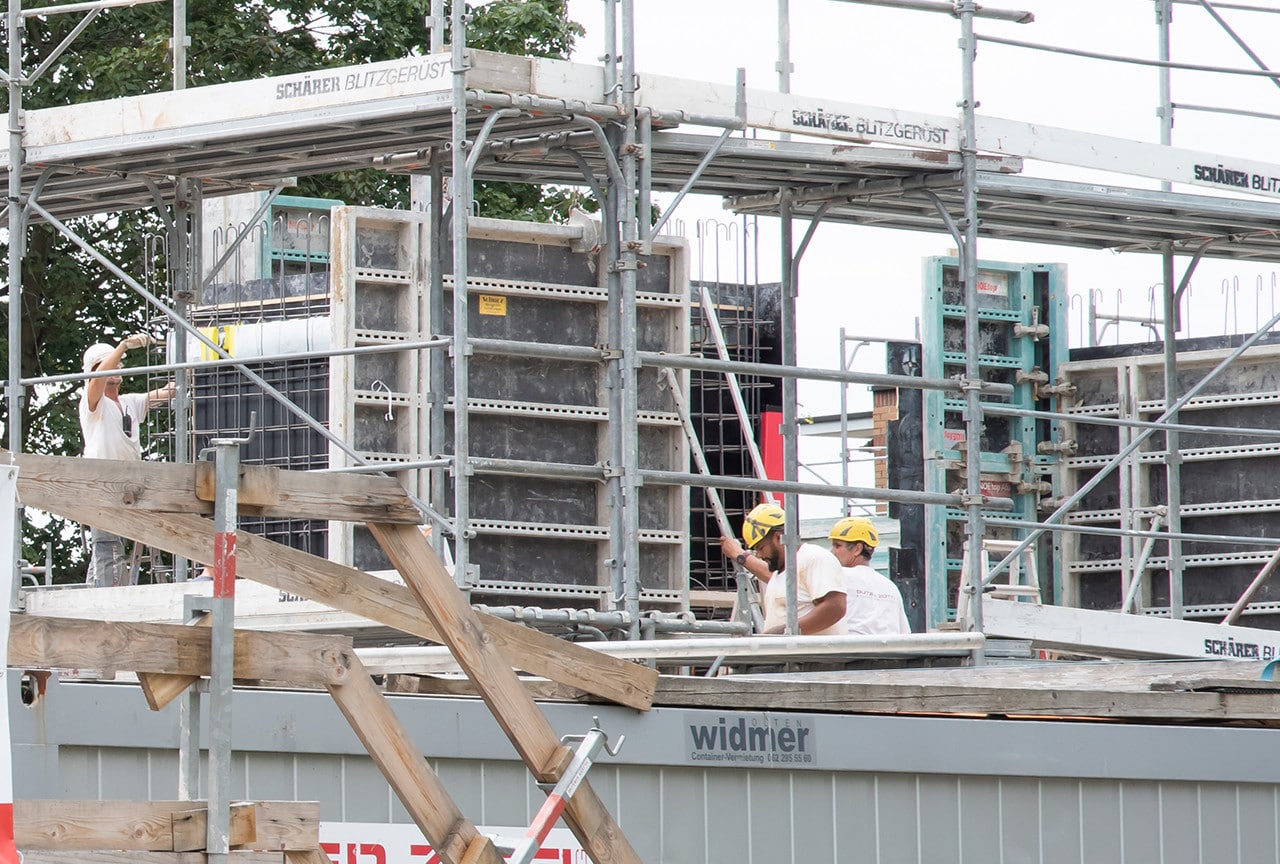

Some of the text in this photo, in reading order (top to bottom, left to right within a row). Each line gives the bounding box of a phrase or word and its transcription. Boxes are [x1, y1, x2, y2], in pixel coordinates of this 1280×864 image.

[276, 60, 451, 100] SCHÄRER BLITZGERÜST
[1194, 164, 1250, 188] SCHÄRER
[1204, 637, 1260, 660] SCHÄRER
[689, 717, 810, 752] widmer
